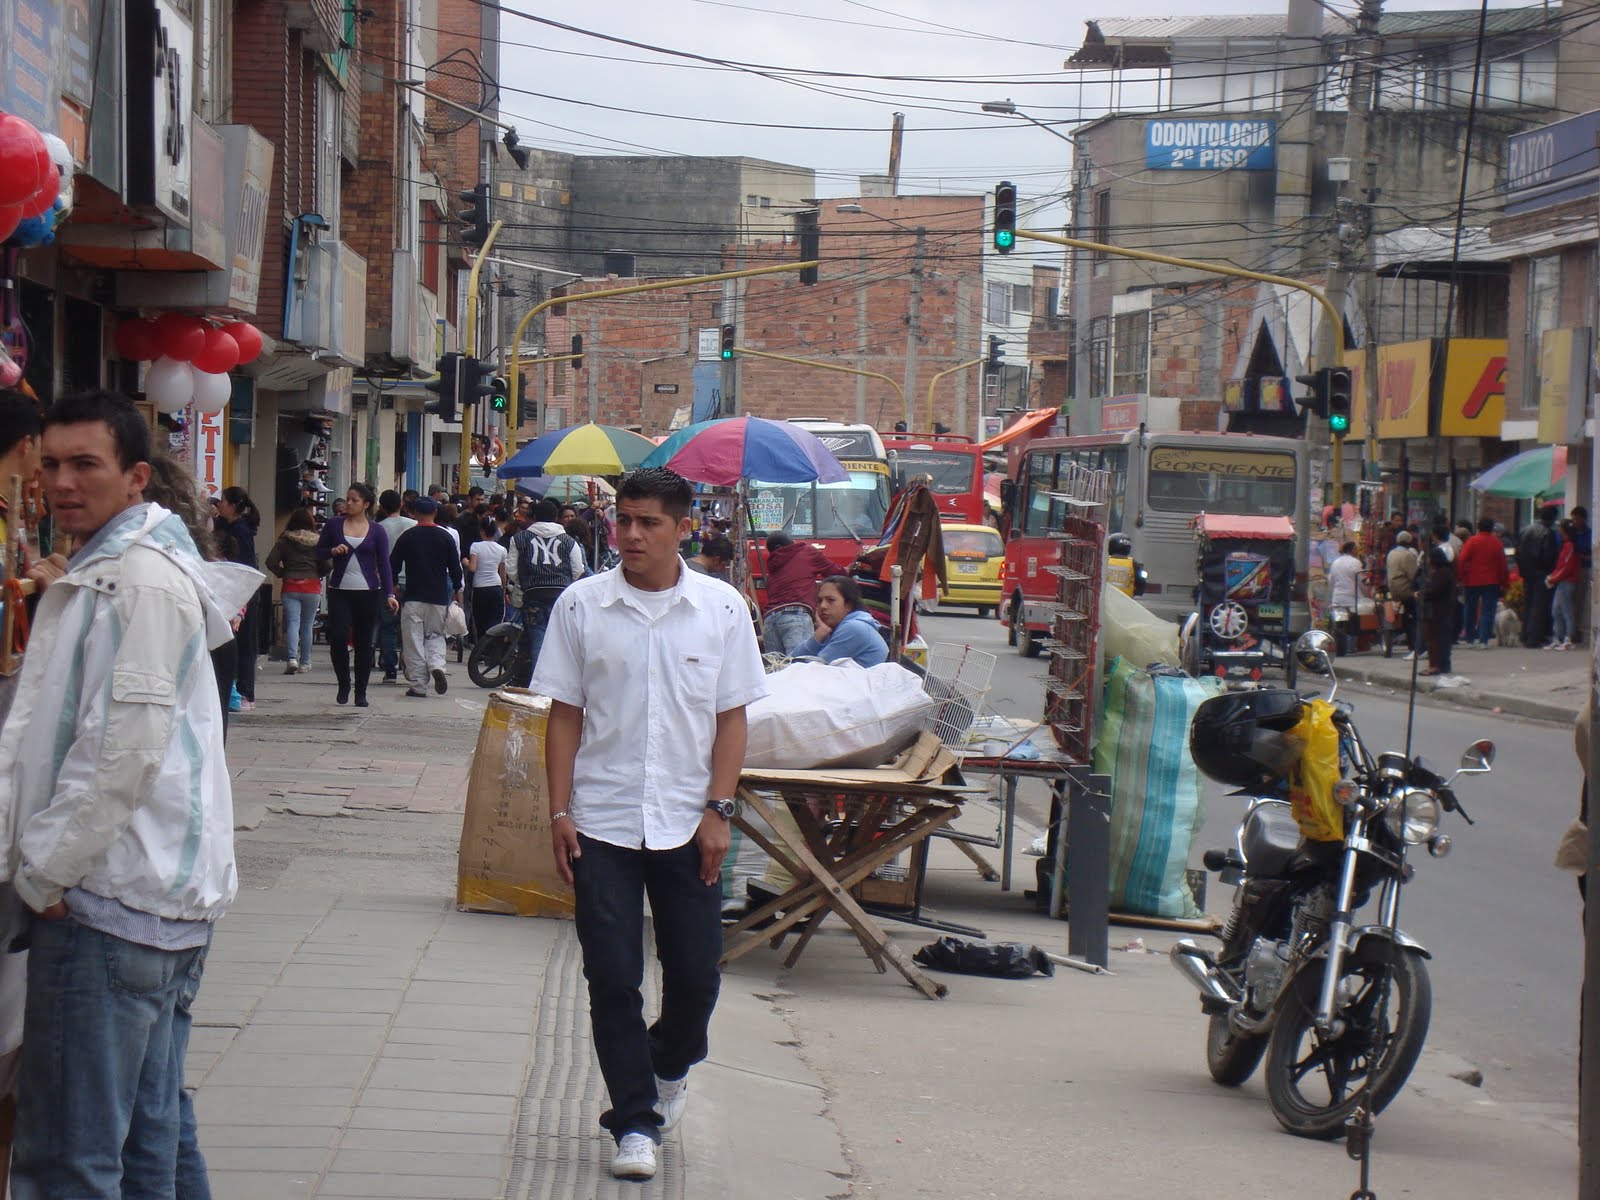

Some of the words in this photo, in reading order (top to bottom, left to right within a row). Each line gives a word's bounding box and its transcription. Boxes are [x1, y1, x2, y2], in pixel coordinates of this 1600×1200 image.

[1151, 122, 1270, 147] ODONTOLOGIA
[1199, 148, 1248, 168] PISO
[1154, 460, 1293, 476] CORRIENTE
